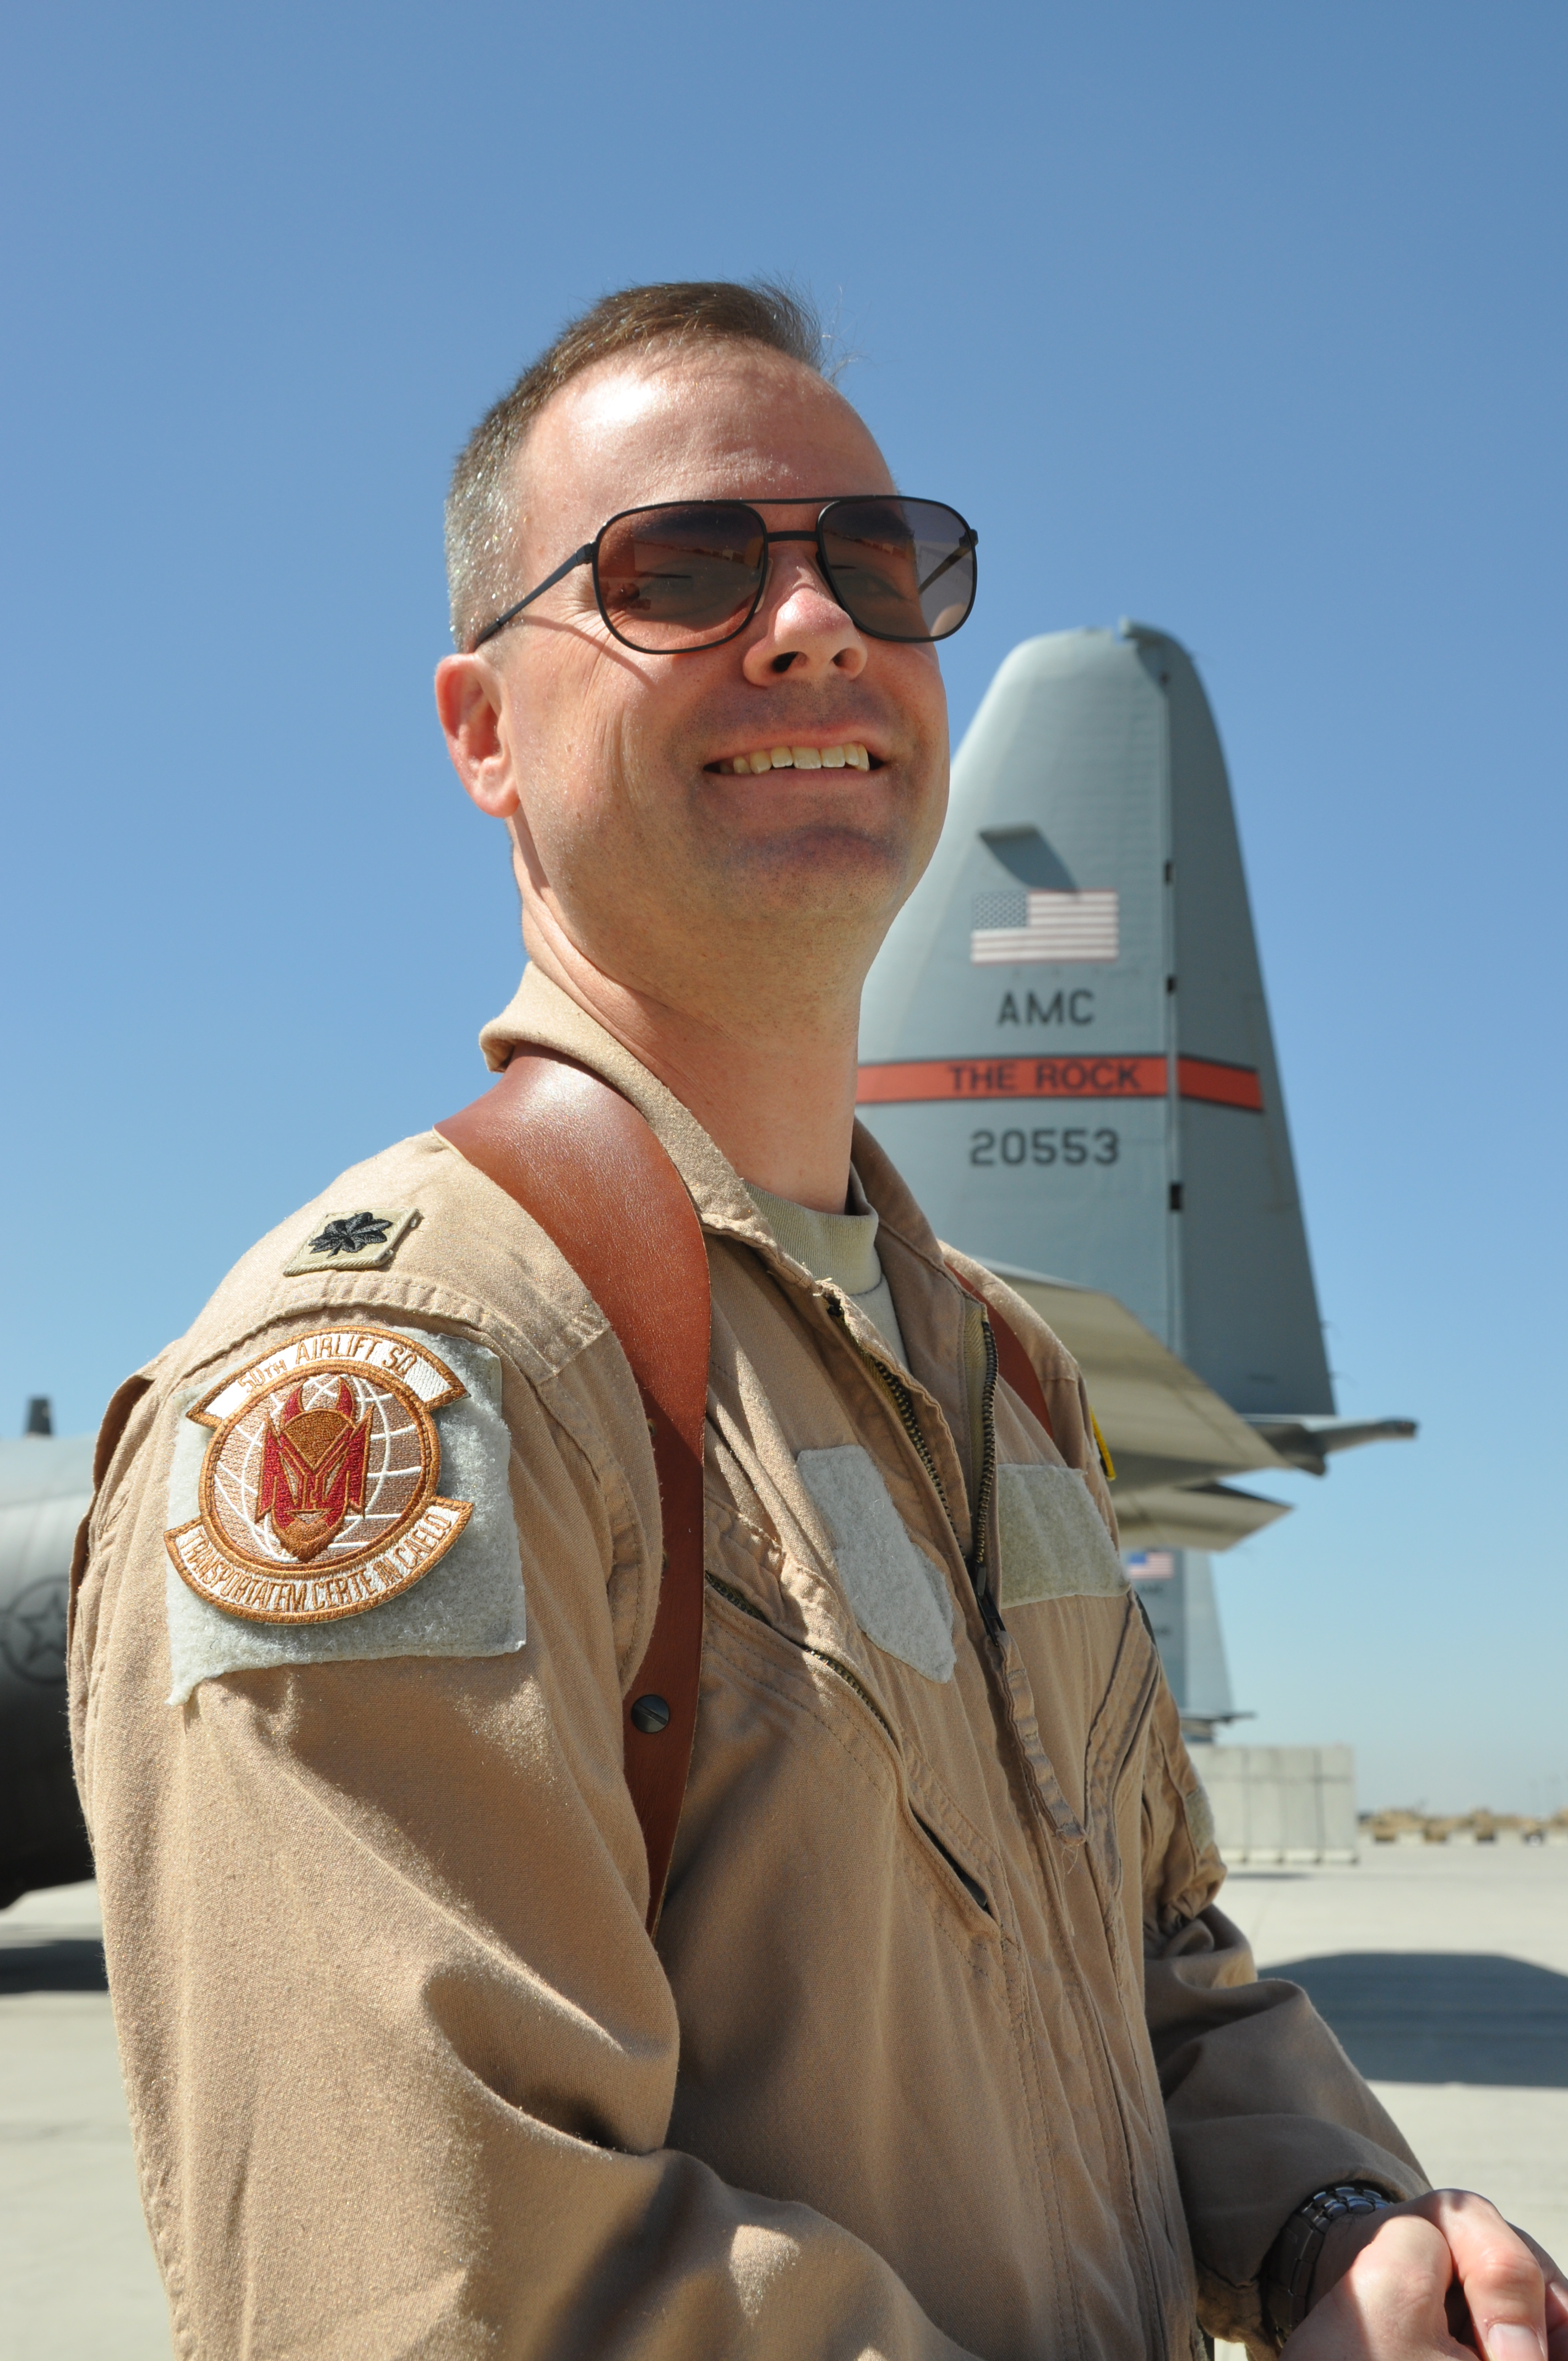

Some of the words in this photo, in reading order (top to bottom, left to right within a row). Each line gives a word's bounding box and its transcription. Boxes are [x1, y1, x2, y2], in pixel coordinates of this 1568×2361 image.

[997, 989, 1095, 1026] AMC
[949, 1064, 1017, 1091] THE
[1036, 1062, 1141, 1091] ROCK
[970, 1129, 1120, 1166] 20553
[238, 1359, 287, 1392] 50TH
[296, 1335, 383, 1364] AIRLIFT
[381, 1345, 417, 1374] SQ
[312, 1569, 378, 1609] CERTE
[372, 1557, 403, 1586] IN
[394, 1513, 451, 1570] CAELO
